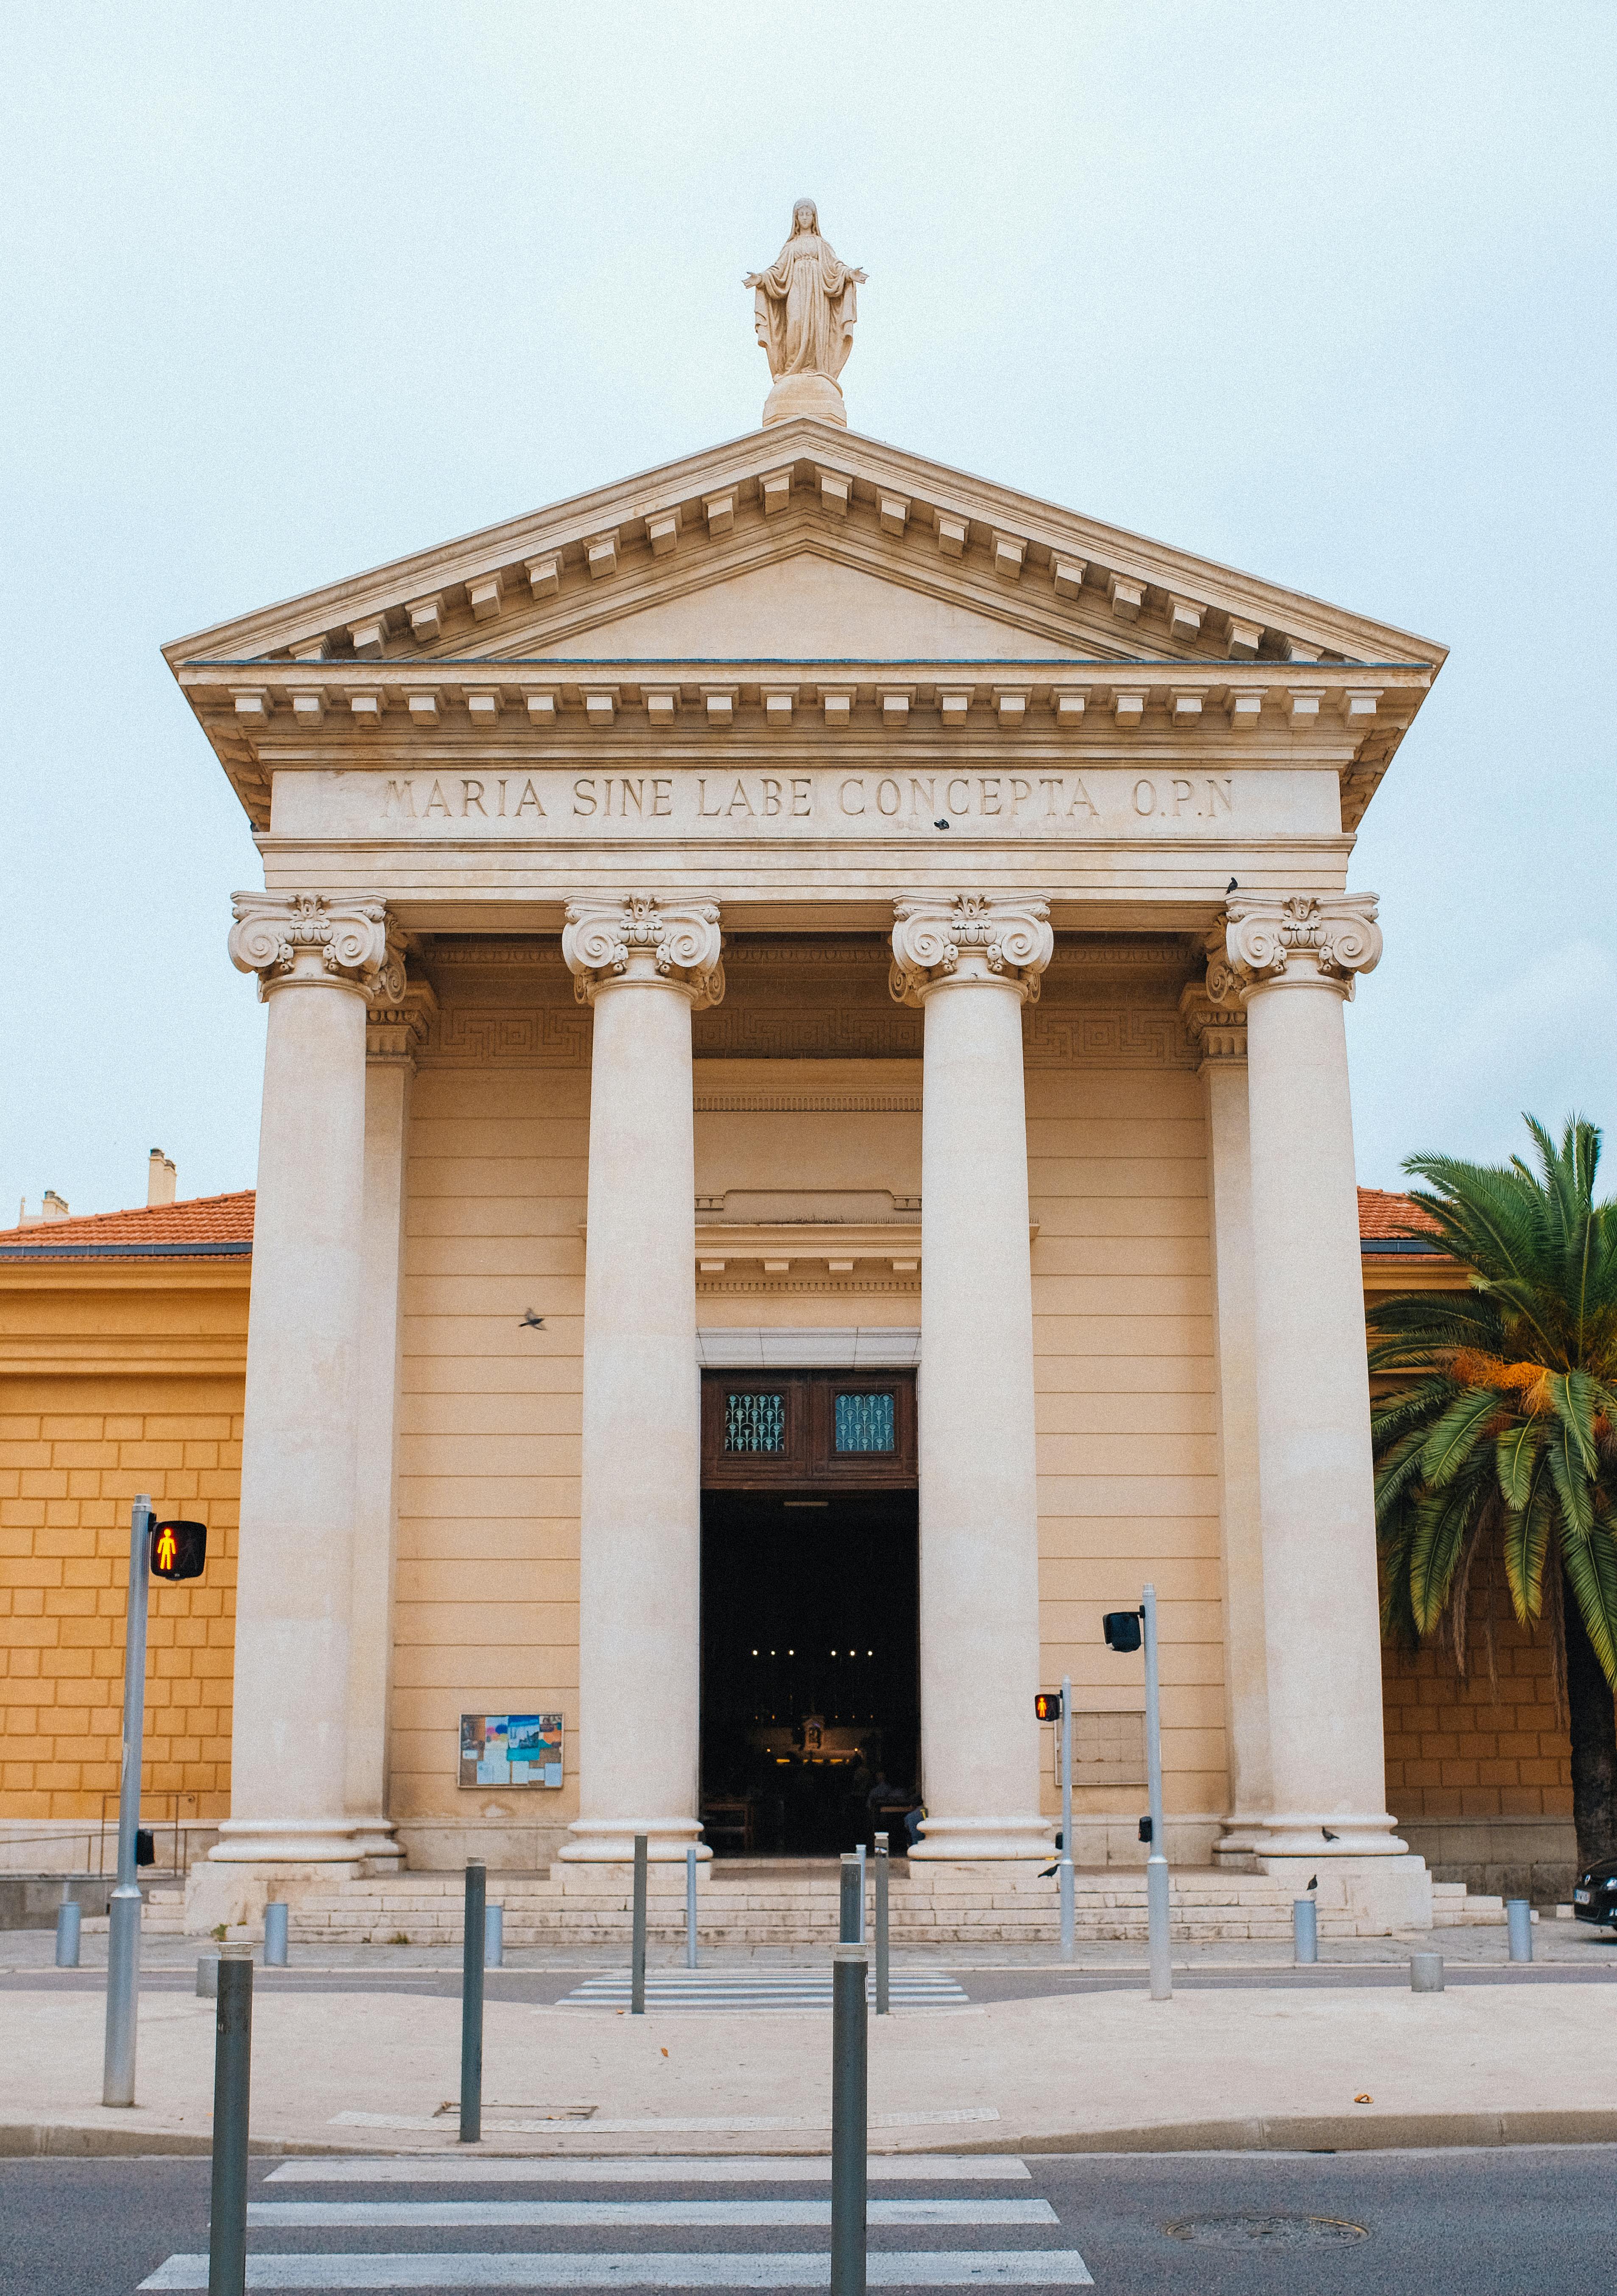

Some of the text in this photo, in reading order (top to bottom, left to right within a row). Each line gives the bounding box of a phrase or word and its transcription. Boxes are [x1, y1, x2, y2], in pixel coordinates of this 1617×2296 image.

[380, 778, 547, 817] MARIA
[573, 778, 673, 817] SINE
[697, 778, 812, 817] LABE
[837, 778, 1100, 817] CONCEPTA
